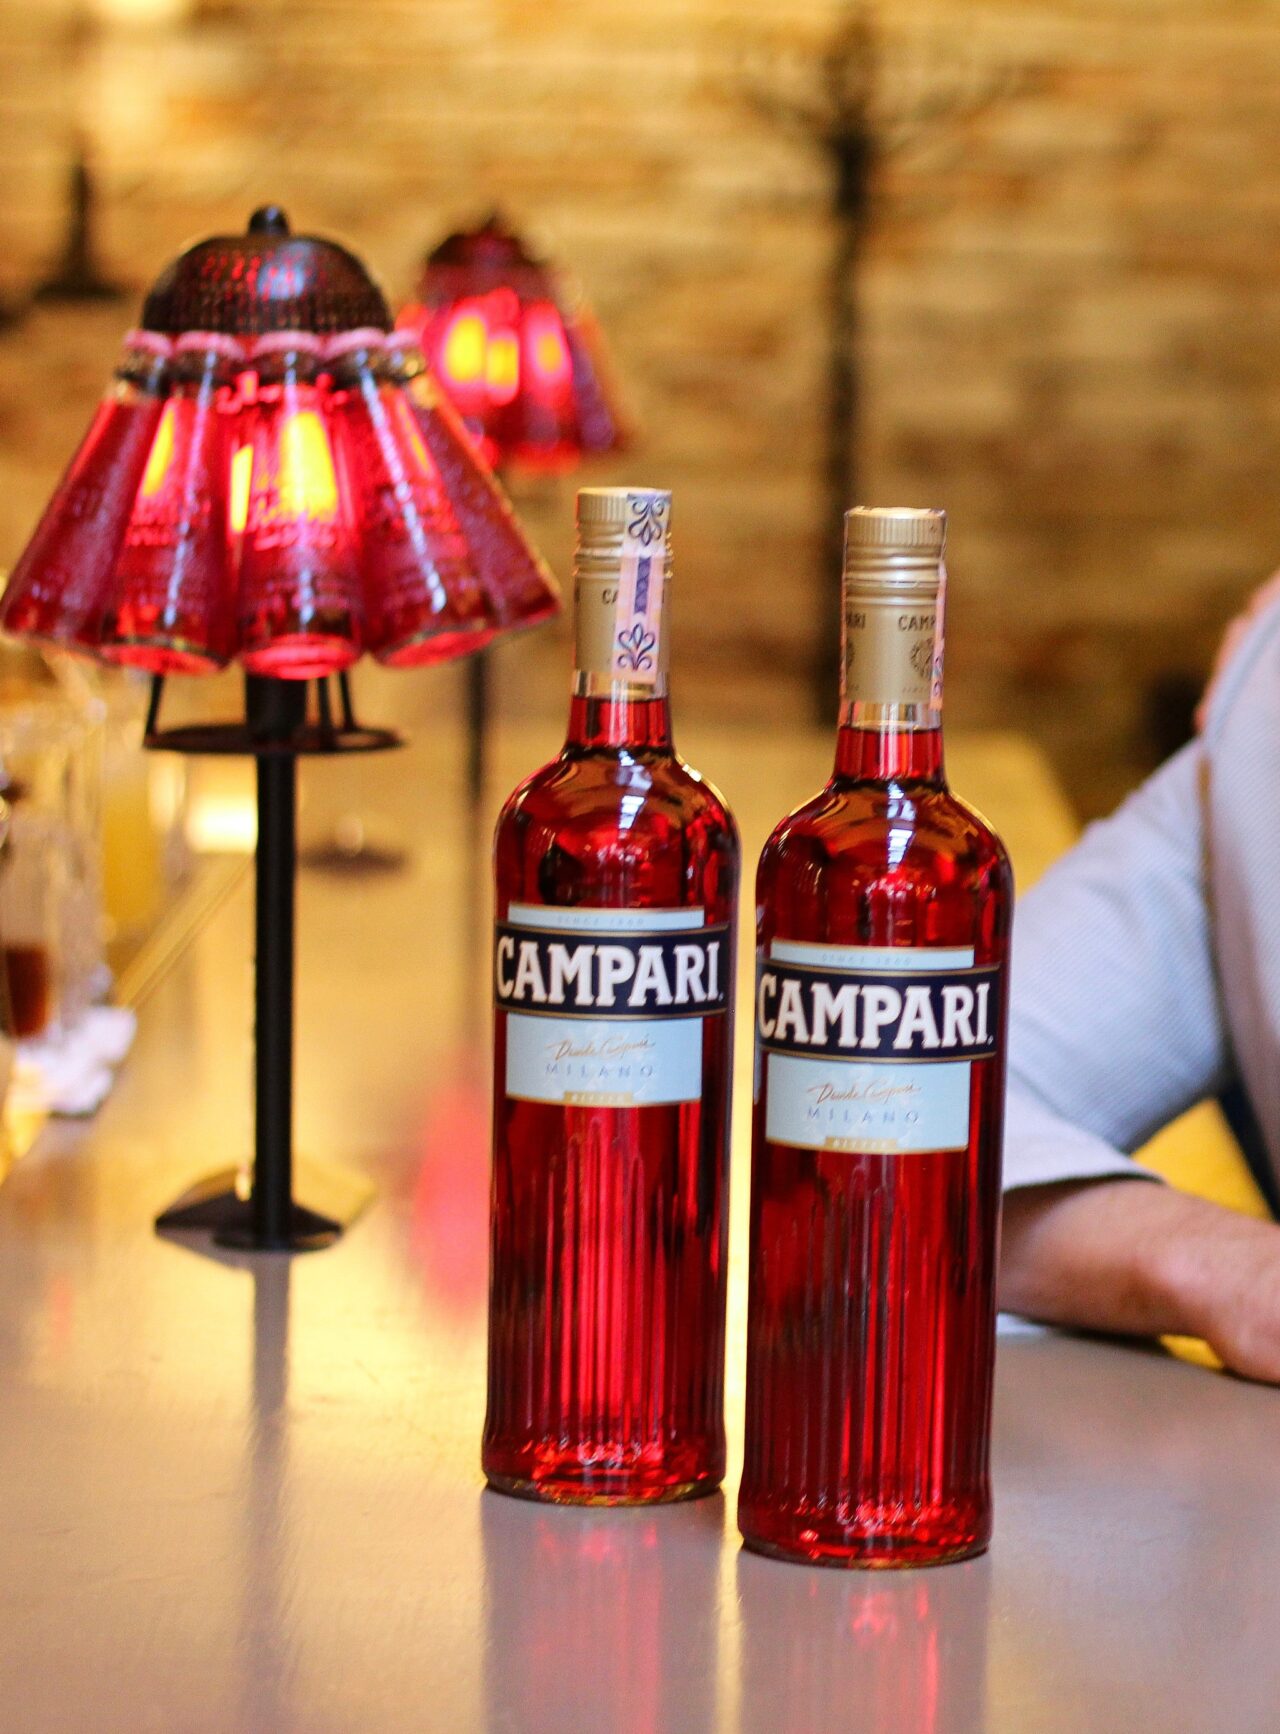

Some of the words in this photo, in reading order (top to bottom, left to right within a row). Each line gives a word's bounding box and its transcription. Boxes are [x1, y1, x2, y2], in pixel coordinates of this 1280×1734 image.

[898, 614, 937, 632] CAMP
[496, 935, 721, 1007] CAMPARI
[758, 973, 991, 1049] CAMPARI
[545, 1063, 654, 1078] MILANO
[807, 1106, 920, 1123] MILANO
